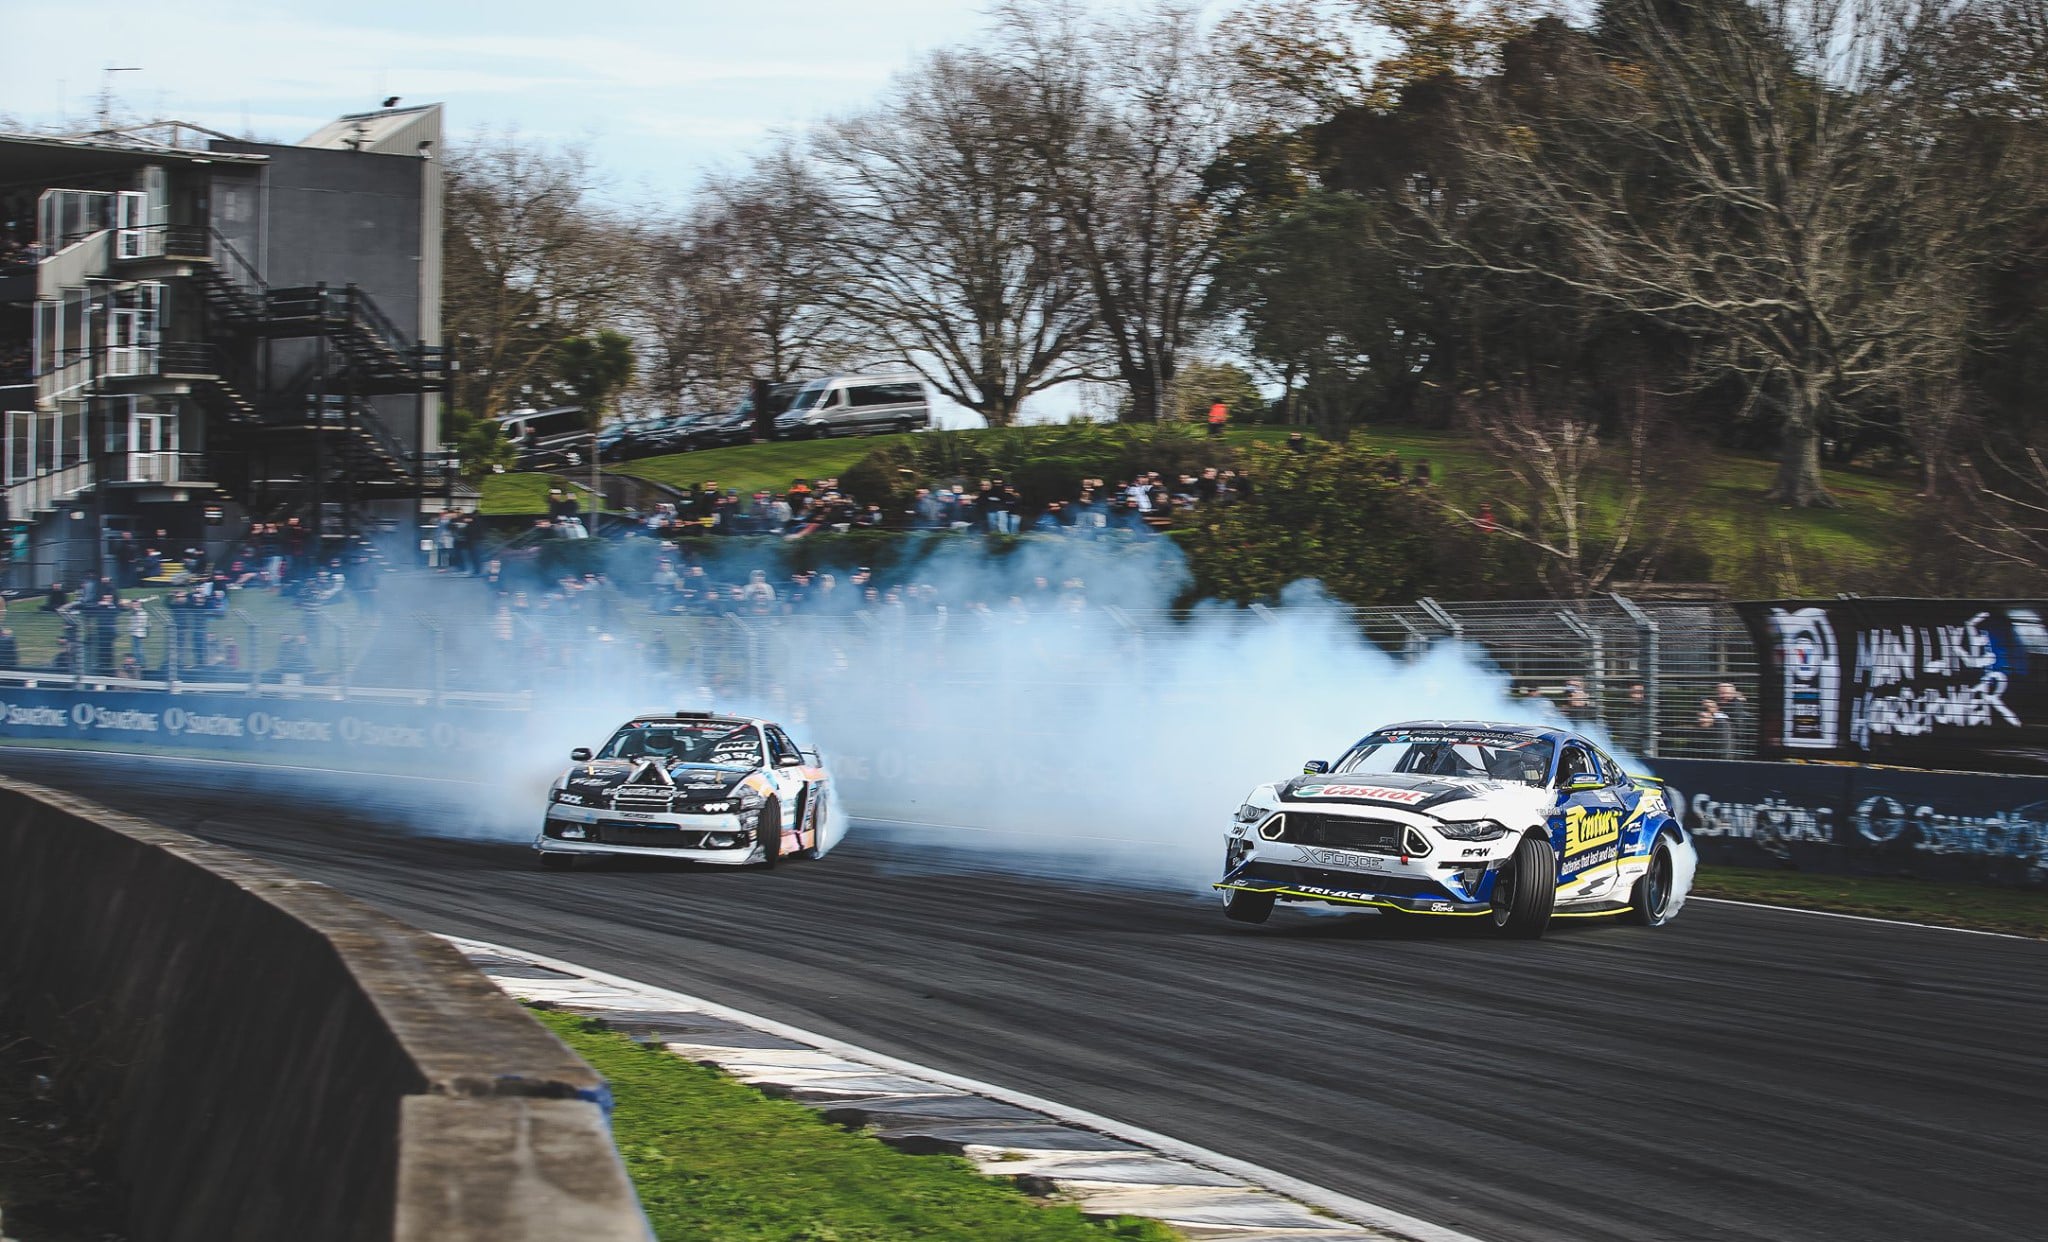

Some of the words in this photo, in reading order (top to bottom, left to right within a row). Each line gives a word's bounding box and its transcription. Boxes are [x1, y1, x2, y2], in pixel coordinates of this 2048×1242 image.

[1920, 612, 1996, 676] LIKE
[1324, 785, 1417, 801] Castrol
[1298, 885, 1375, 901] TRI-ACE
[1431, 902, 1454, 912] Ford
